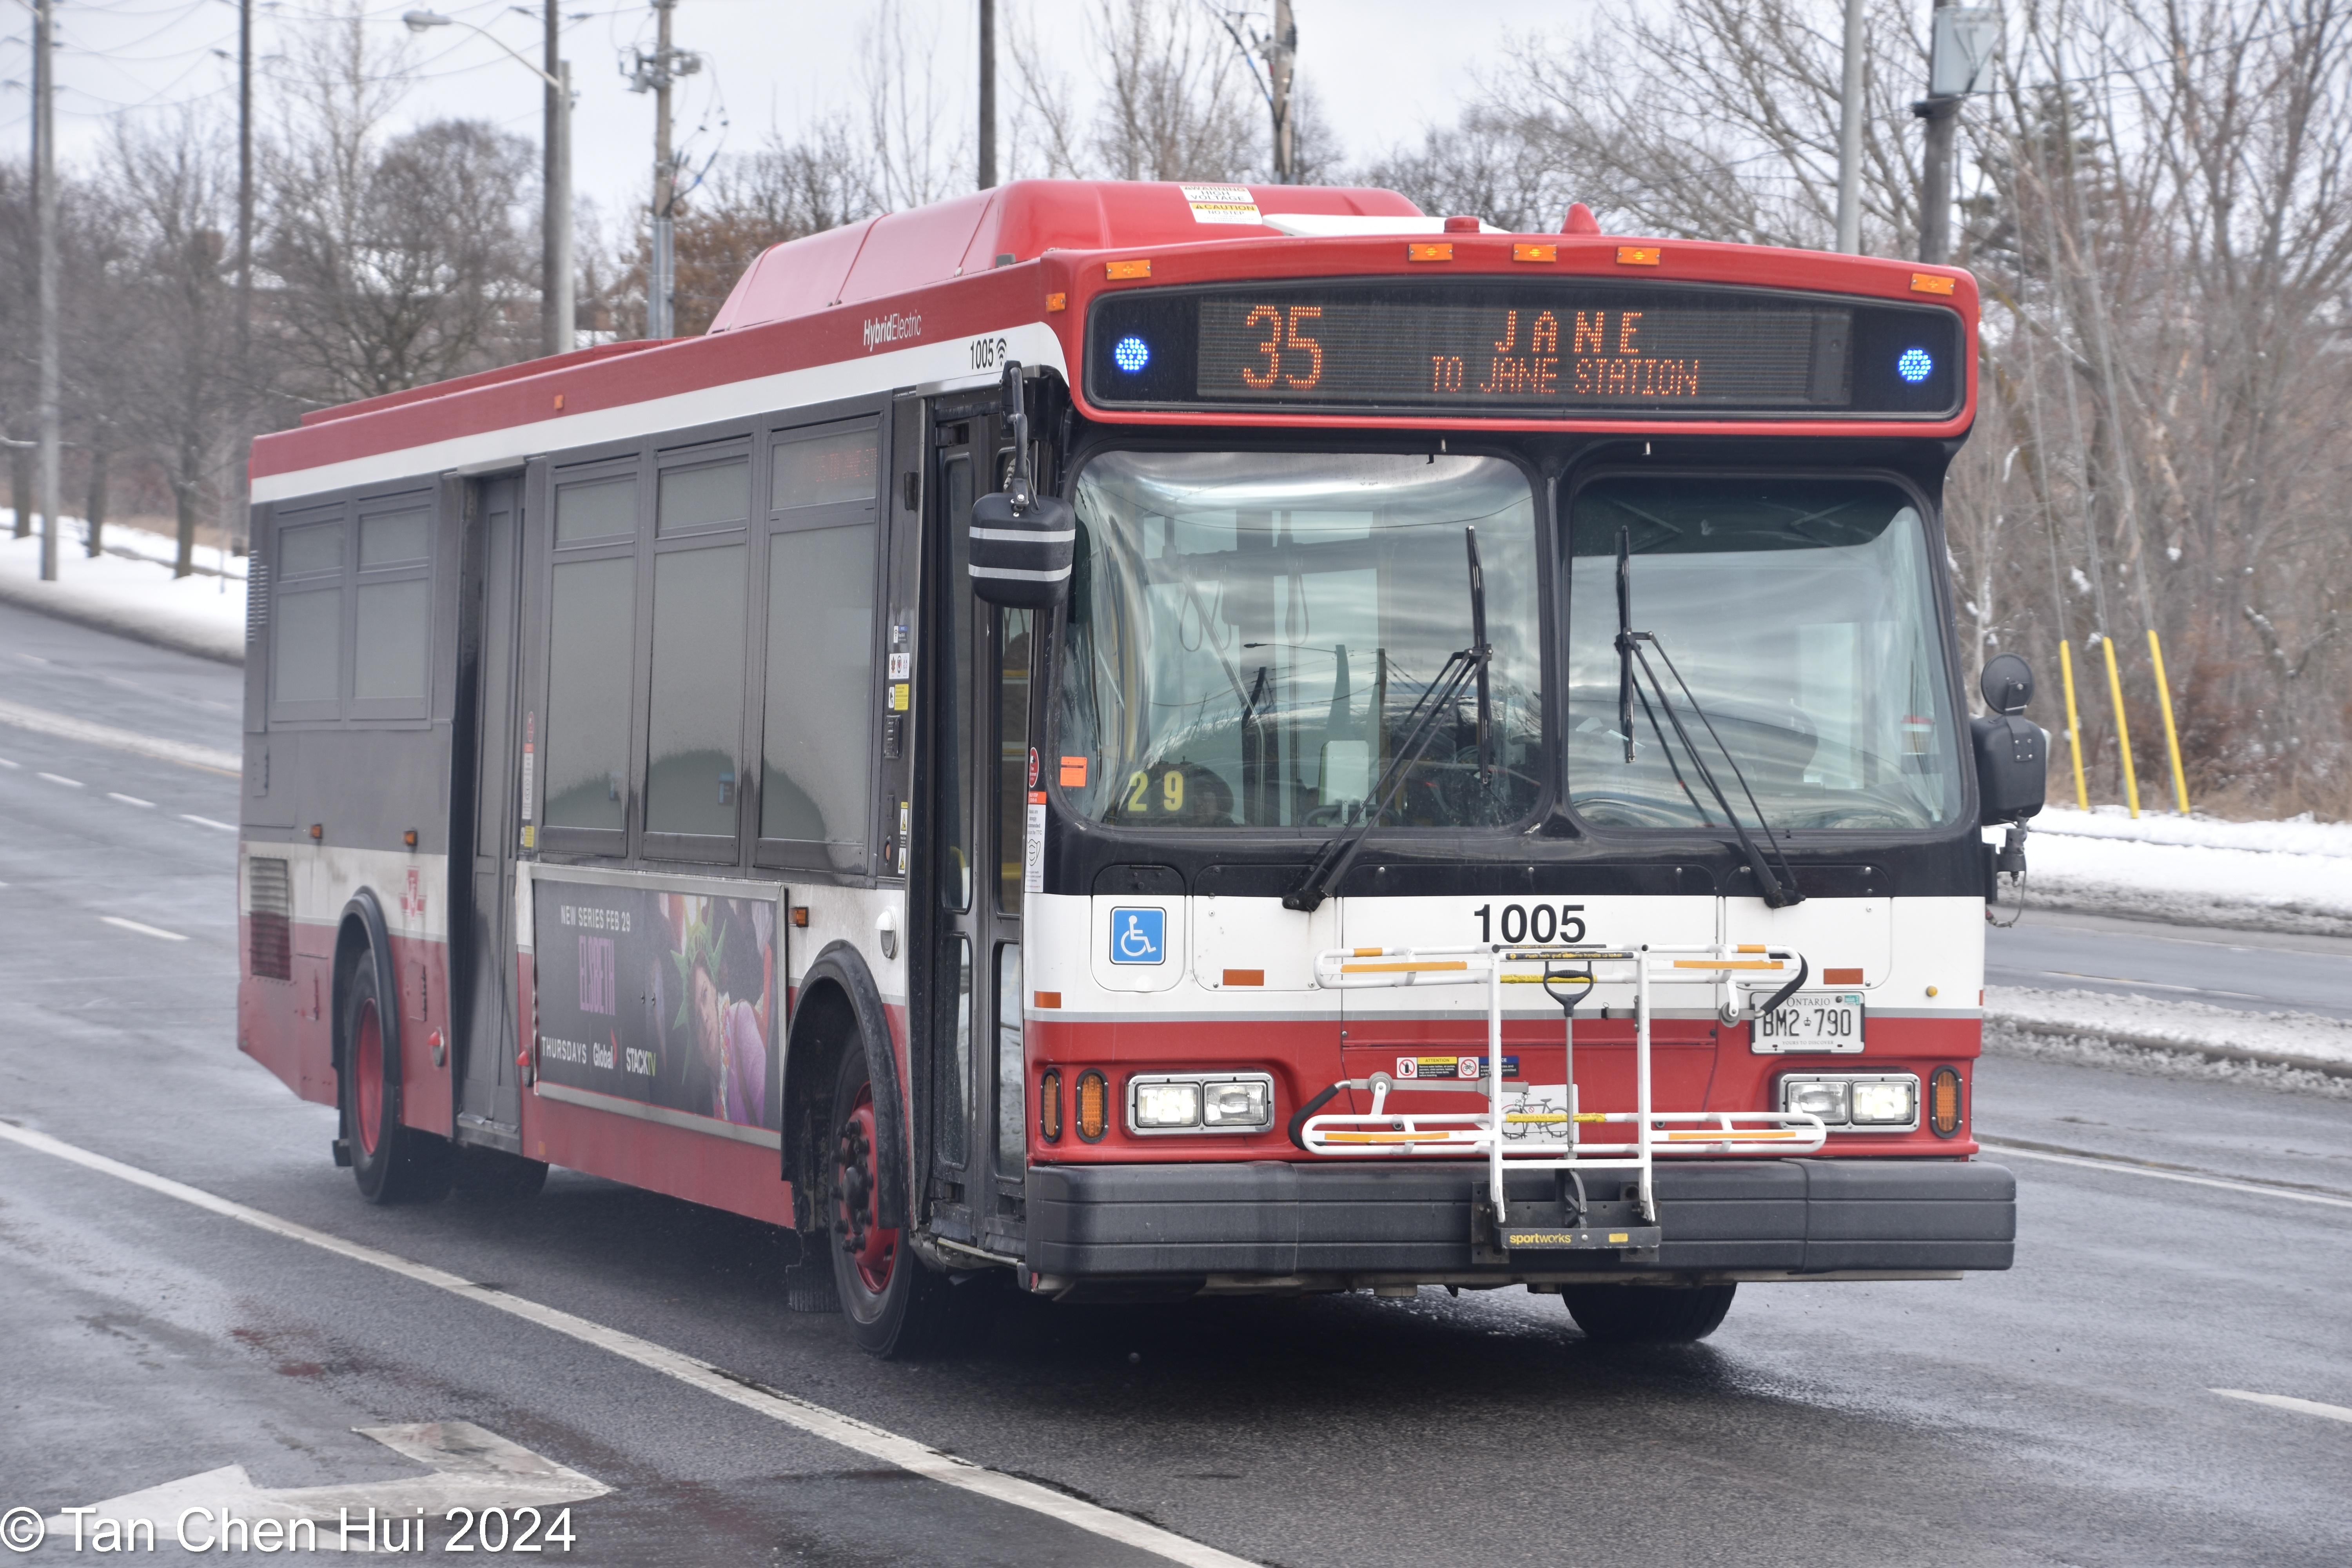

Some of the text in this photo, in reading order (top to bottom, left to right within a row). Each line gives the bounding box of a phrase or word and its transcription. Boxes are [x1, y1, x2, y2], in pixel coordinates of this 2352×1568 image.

[864, 309, 922, 352] HybridElectric
[1241, 304, 1323, 390] 35
[1494, 309, 1643, 354] JANE
[970, 338, 994, 370] 1005
[1432, 355, 1699, 396] TO JANE STATION
[1127, 770, 1184, 812] 29
[561, 905, 631, 932] NEW SERIES FEB 29
[1474, 904, 1586, 944] 1005
[1786, 997, 1830, 1007] ONTARIO
[1763, 1009, 1851, 1036] BM2 790
[541, 1036, 656, 1076] THURSDAYS Global STACKTV
[1509, 1232, 1572, 1245] sportworks
